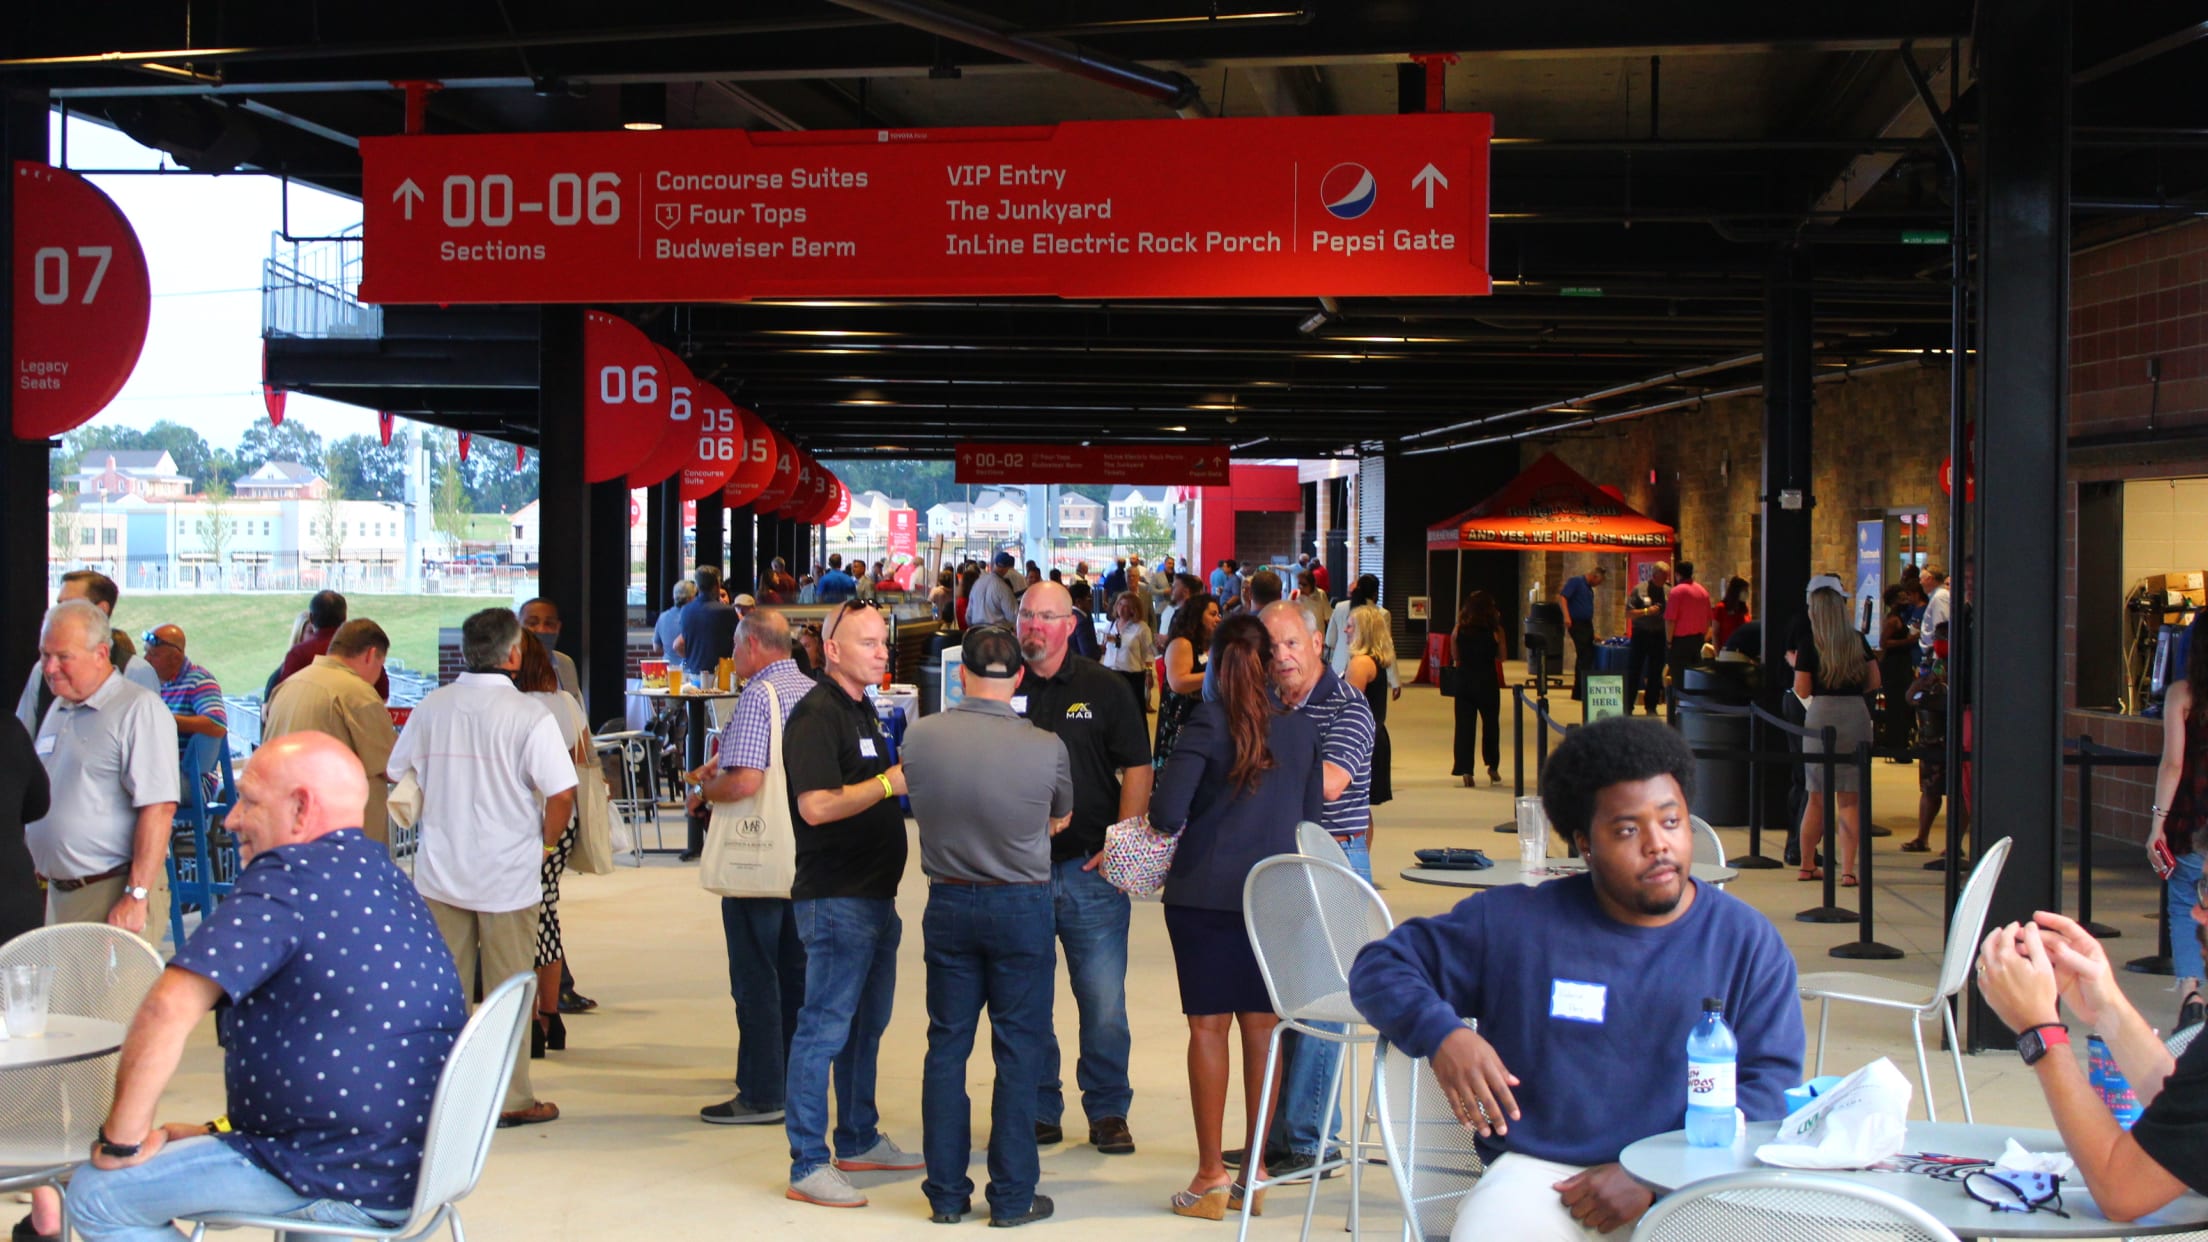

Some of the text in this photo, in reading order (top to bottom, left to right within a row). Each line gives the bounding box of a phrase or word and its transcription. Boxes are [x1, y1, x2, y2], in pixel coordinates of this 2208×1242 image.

[656, 167, 868, 191] Concourse Suites
[947, 164, 1066, 190] VIP Entry
[443, 172, 621, 227] 00-06
[690, 204, 745, 224] Four
[751, 203, 807, 229] Tops
[946, 198, 1111, 225] The Junkyard
[440, 240, 546, 261] Sections
[656, 236, 856, 259] Budweiser Berm
[946, 230, 1281, 255] InLine Electric Rock Porch
[1312, 229, 1456, 257] Pepsi Gate
[34, 245, 113, 305] 07
[21, 359, 69, 375] Legacy
[21, 375, 61, 390] Seats
[600, 365, 658, 404] 06
[699, 437, 734, 460] 06
[976, 453, 1024, 467] 00-02
[1468, 529, 1496, 541] AND
[1500, 530, 1530, 543] YES,
[1533, 530, 1553, 543] WE
[1556, 530, 1588, 543] HIDE
[1589, 686, 1622, 695] ENTER
[1592, 698, 1618, 706] HERE
